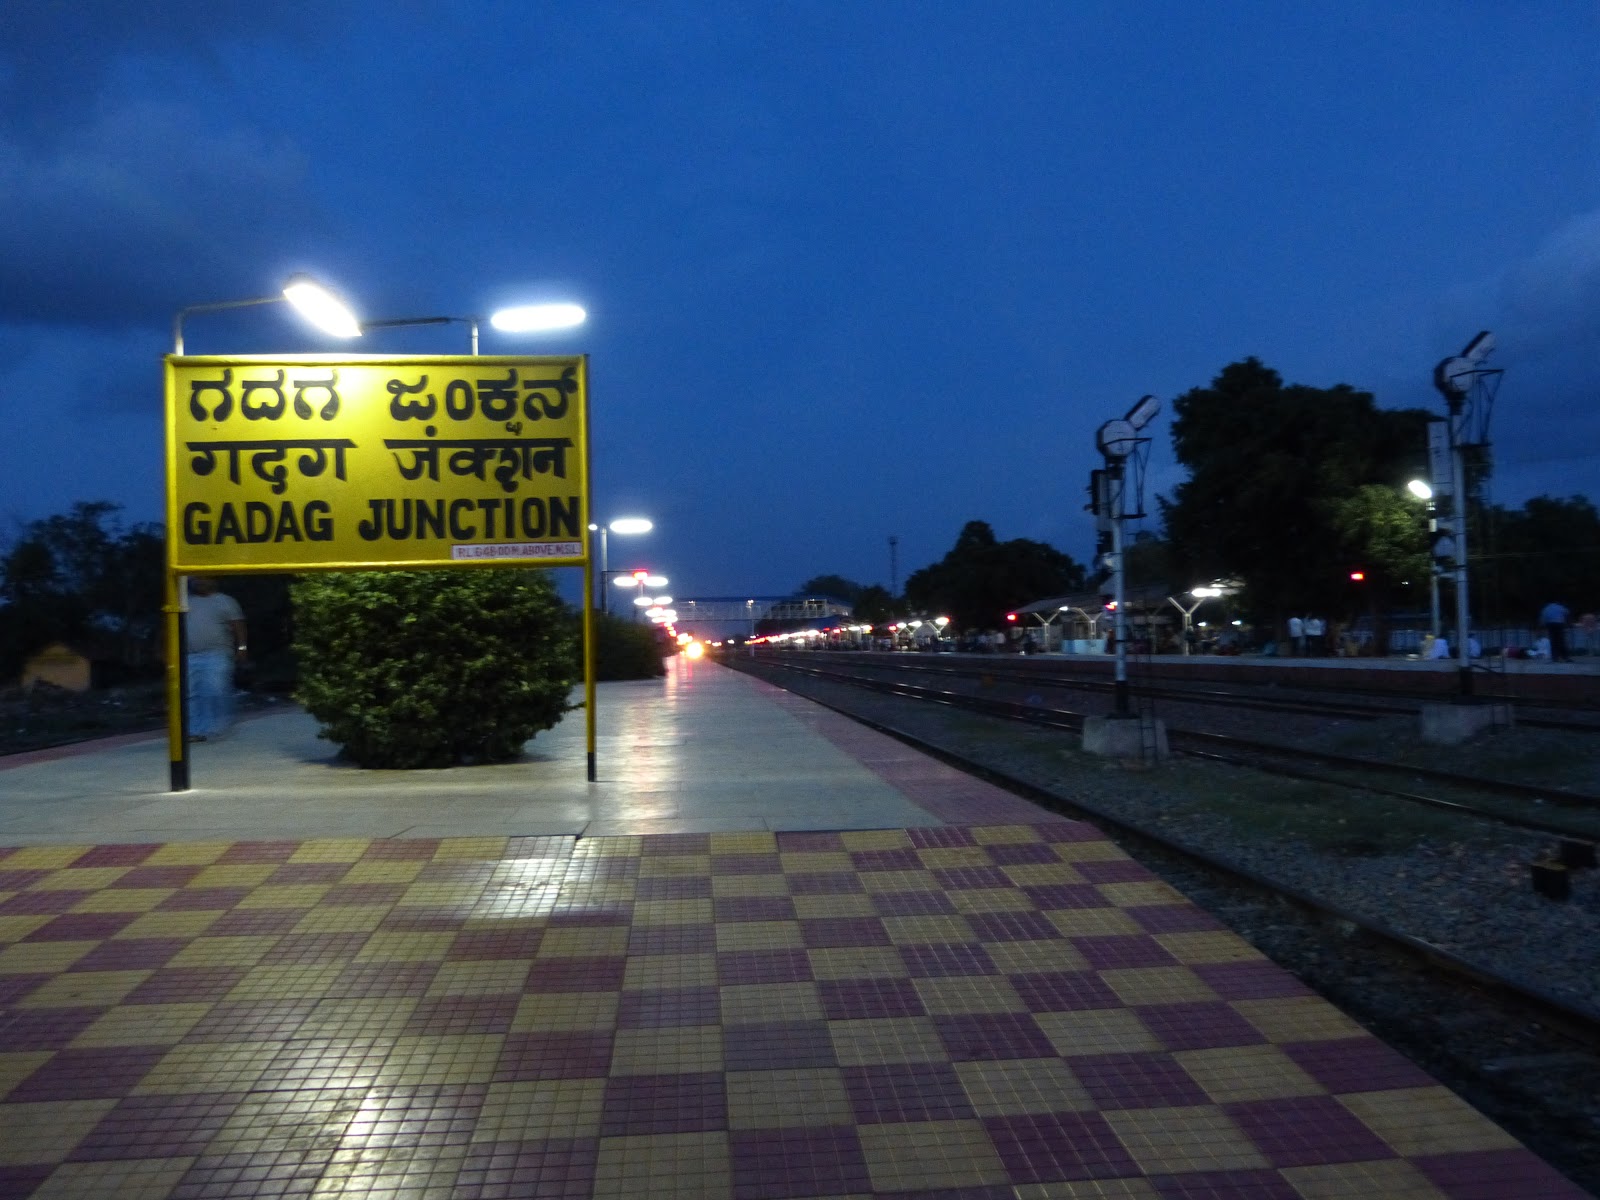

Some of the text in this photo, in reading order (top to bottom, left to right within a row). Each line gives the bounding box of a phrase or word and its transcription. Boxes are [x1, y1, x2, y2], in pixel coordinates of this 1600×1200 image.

[189, 368, 340, 422] ಗದಗ
[186, 425, 574, 495] गदग जंक्शन
[184, 495, 580, 545] GADAG JUNCTION
